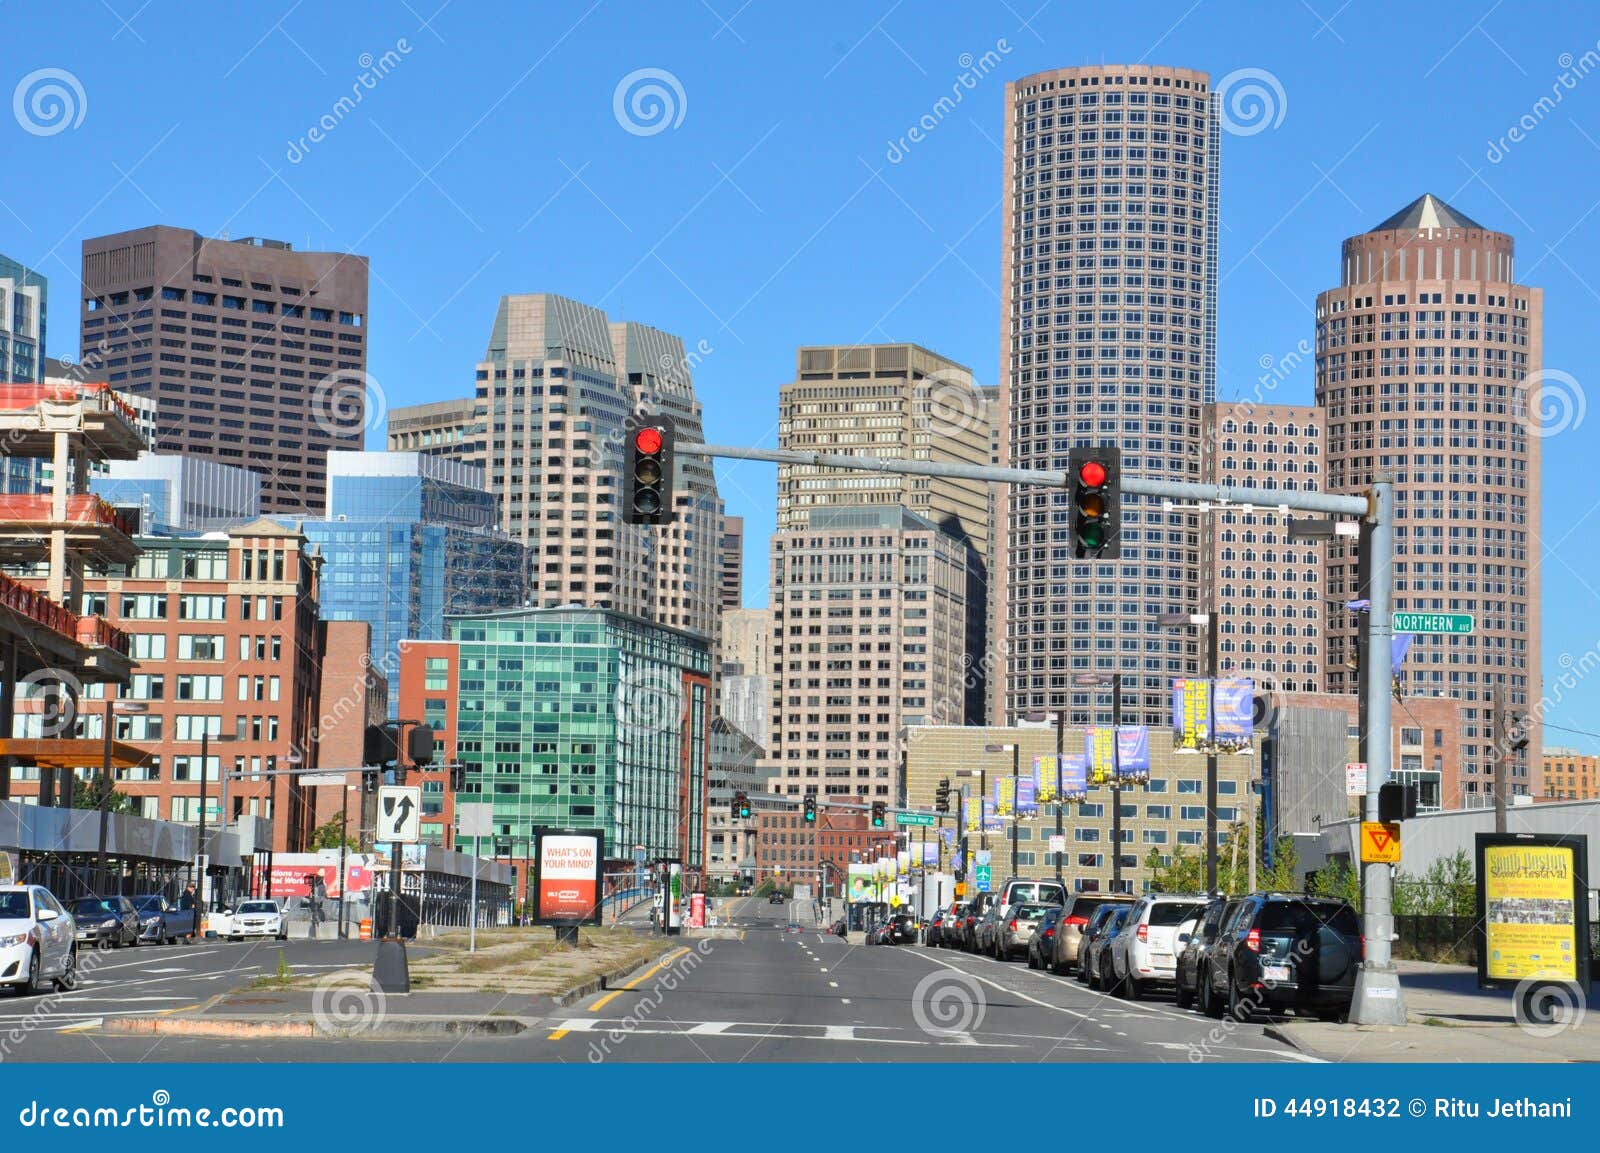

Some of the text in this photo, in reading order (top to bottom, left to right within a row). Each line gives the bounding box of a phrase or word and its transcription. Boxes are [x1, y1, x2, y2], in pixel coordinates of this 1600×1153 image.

[1394, 615, 1470, 632] NORTHERN AVE
[1195, 681, 1207, 721] HERE
[1183, 680, 1196, 748] SUMMER
[546, 848, 592, 857] WHAT'S ON
[544, 859, 594, 869] YOUR MIND?
